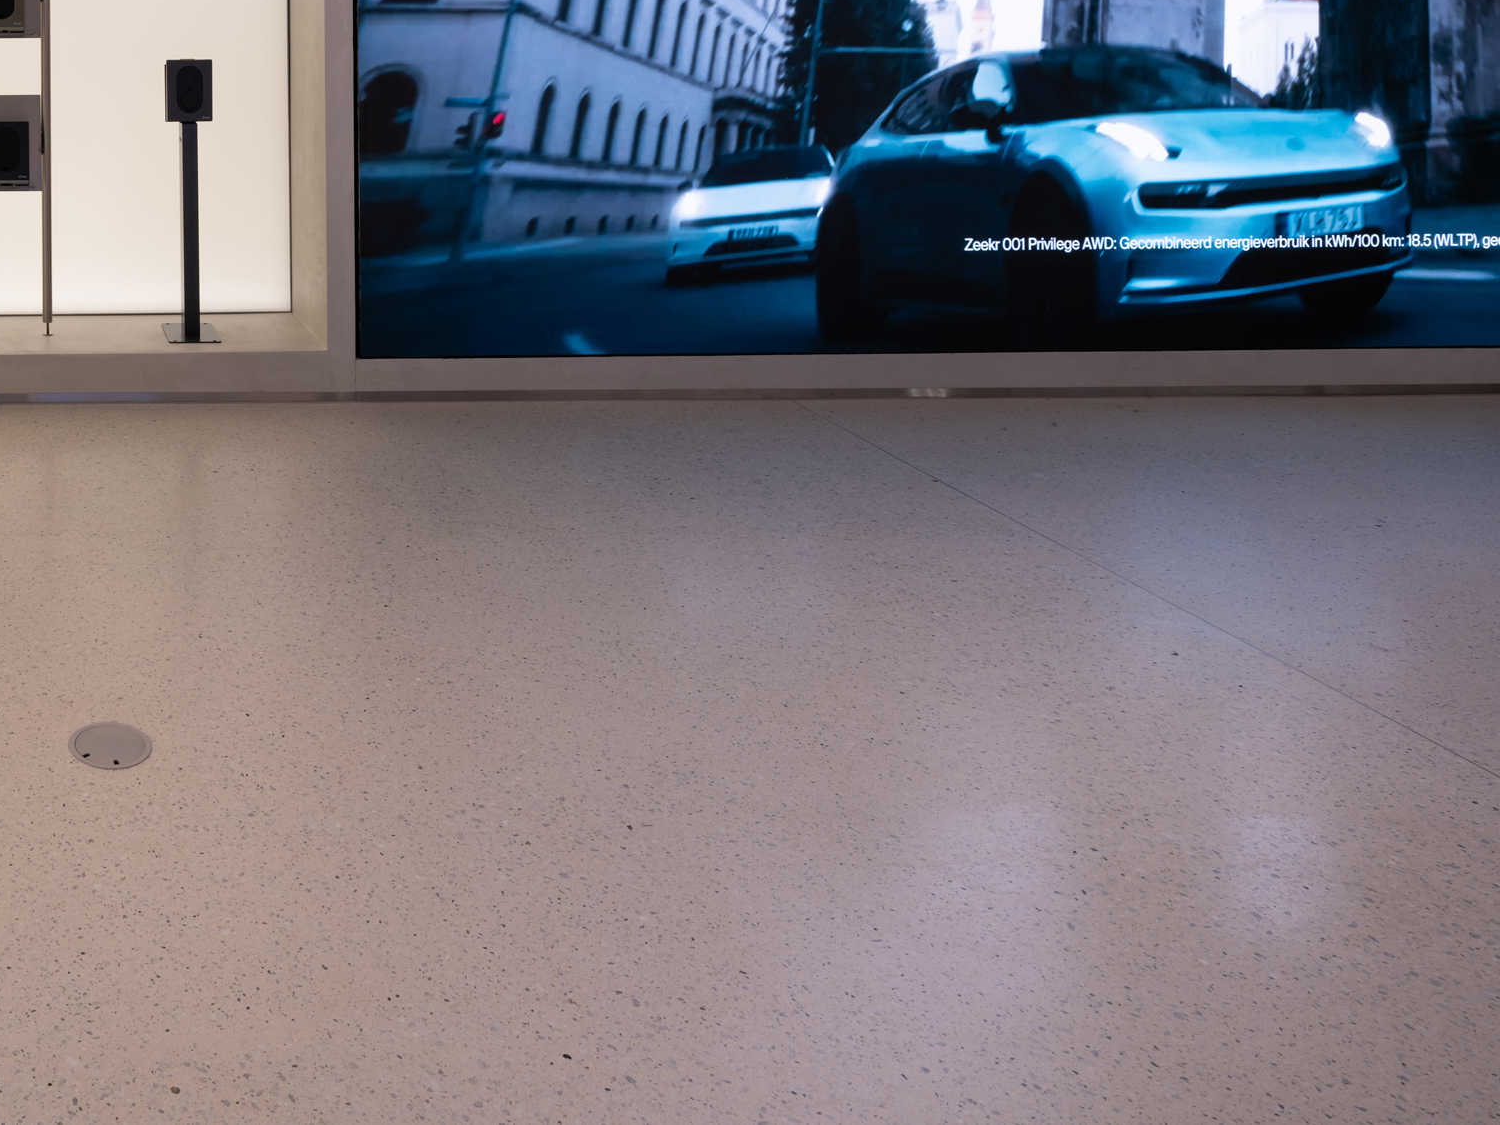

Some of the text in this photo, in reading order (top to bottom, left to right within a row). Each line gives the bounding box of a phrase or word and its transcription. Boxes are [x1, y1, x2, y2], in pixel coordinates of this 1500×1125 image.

[964, 237, 1000, 251] Zeekr
[1002, 237, 1026, 250] 001
[1028, 236, 1080, 253] Privilege
[1082, 236, 1117, 250] AWD:
[1119, 235, 1212, 250] Gecombineerd
[1214, 233, 1310, 252] energieverbruik
[1311, 234, 1324, 248] in
[1325, 233, 1380, 248] kWh/100
[1382, 233, 1405, 247] km:
[1406, 232, 1432, 247] 18.5
[1433, 232, 1480, 249] (WLTP),
